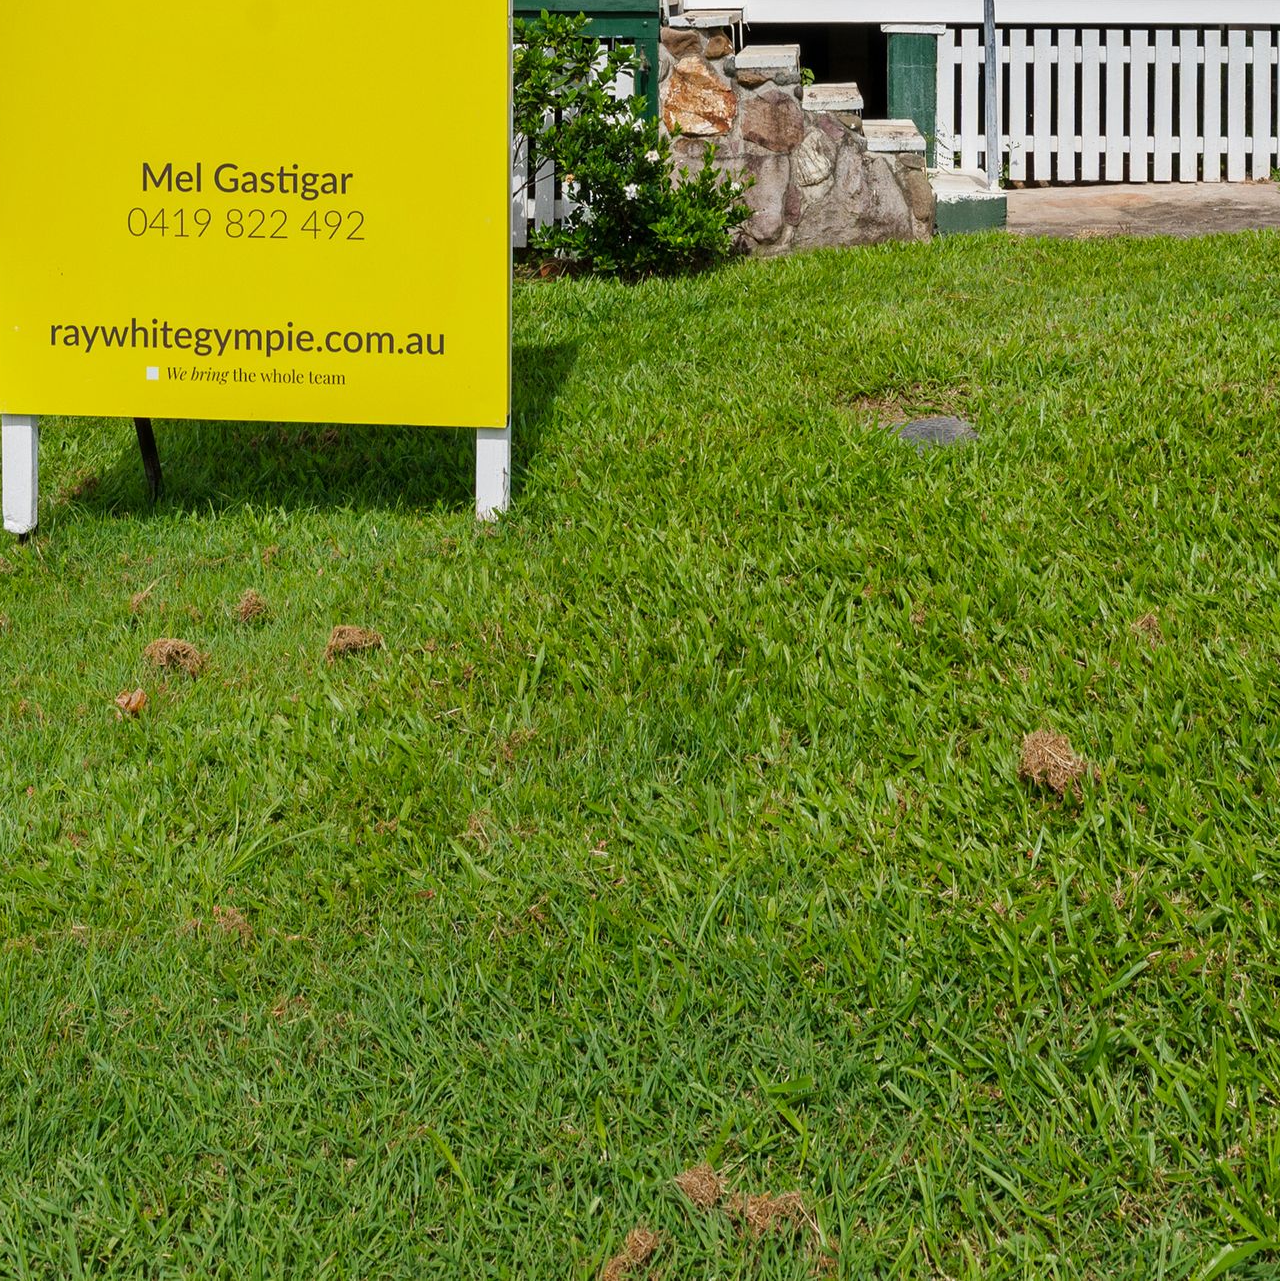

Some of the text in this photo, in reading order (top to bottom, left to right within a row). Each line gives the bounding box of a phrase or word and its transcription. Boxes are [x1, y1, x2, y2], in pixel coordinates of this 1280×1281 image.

[143, 163, 353, 200] Mel Gastigar
[128, 208, 364, 240] 0419 822 492
[51, 318, 444, 357] raywhitegympie.com.au
[168, 367, 345, 384] We bring the whole team
